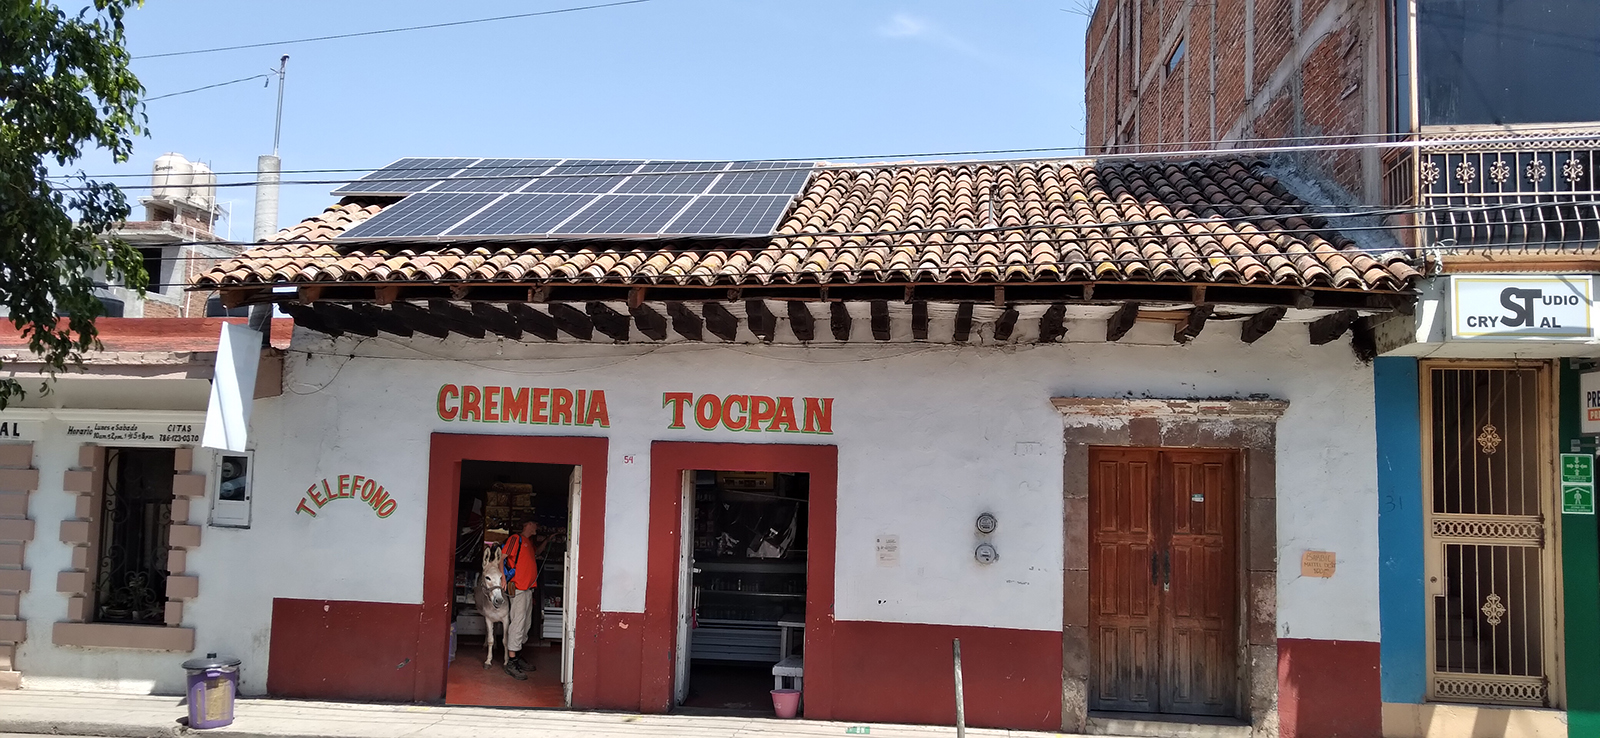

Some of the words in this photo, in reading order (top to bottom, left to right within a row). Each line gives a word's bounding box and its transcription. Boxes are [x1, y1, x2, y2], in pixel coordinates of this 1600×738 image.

[437, 384, 610, 428] CREMERIA
[662, 392, 835, 435] TOCPAN
[67, 426, 93, 435] Horario
[94, 423, 110, 431] Lunes
[115, 423, 138, 431] Sabado
[167, 424, 192, 432] CITAS
[624, 455, 634, 464] 54
[295, 474, 398, 519] TELEFONO
